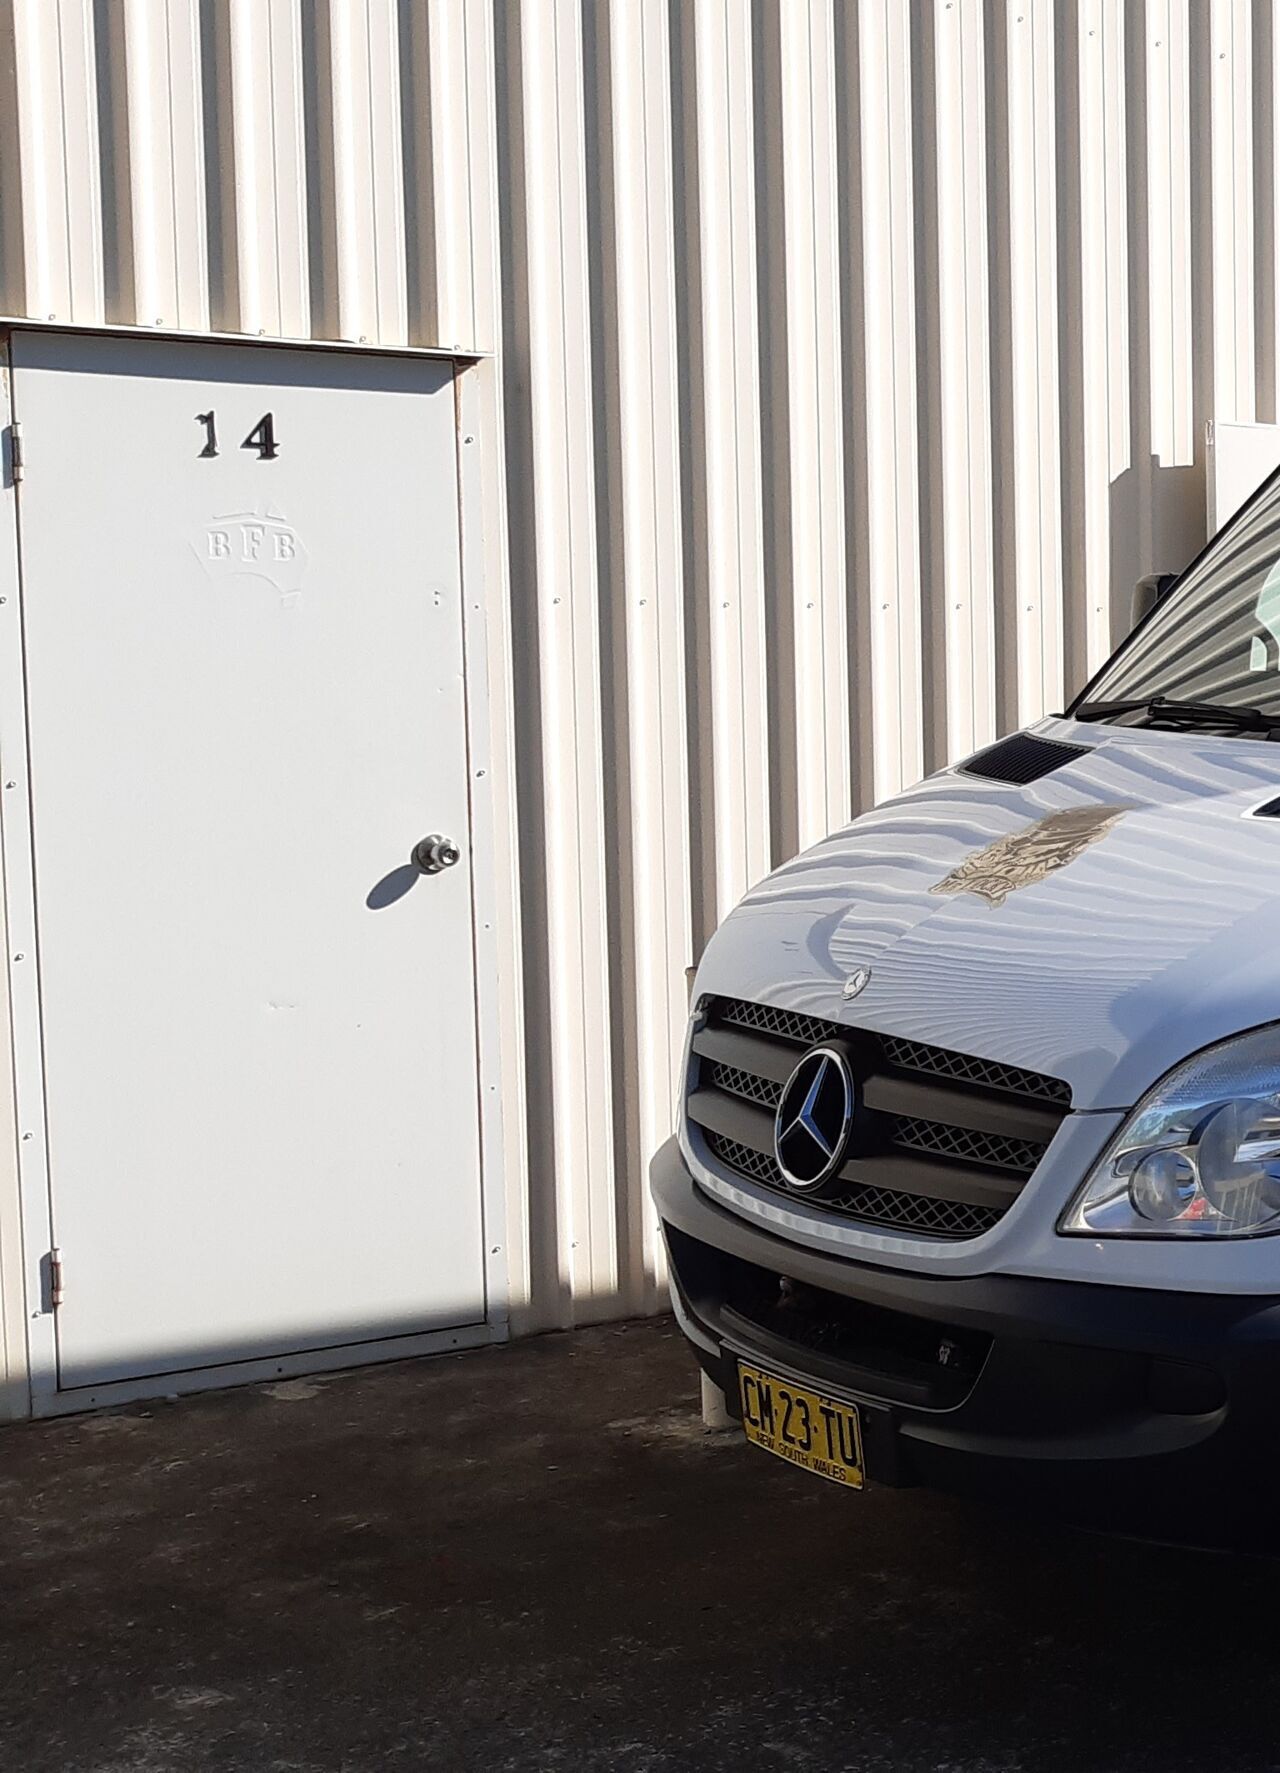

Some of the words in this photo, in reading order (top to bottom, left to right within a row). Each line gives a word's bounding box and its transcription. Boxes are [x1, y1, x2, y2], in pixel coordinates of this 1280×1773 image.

[194, 410, 280, 460] 14
[778, 1443, 808, 1466] SOUTH
[812, 1457, 847, 1481] WALES
